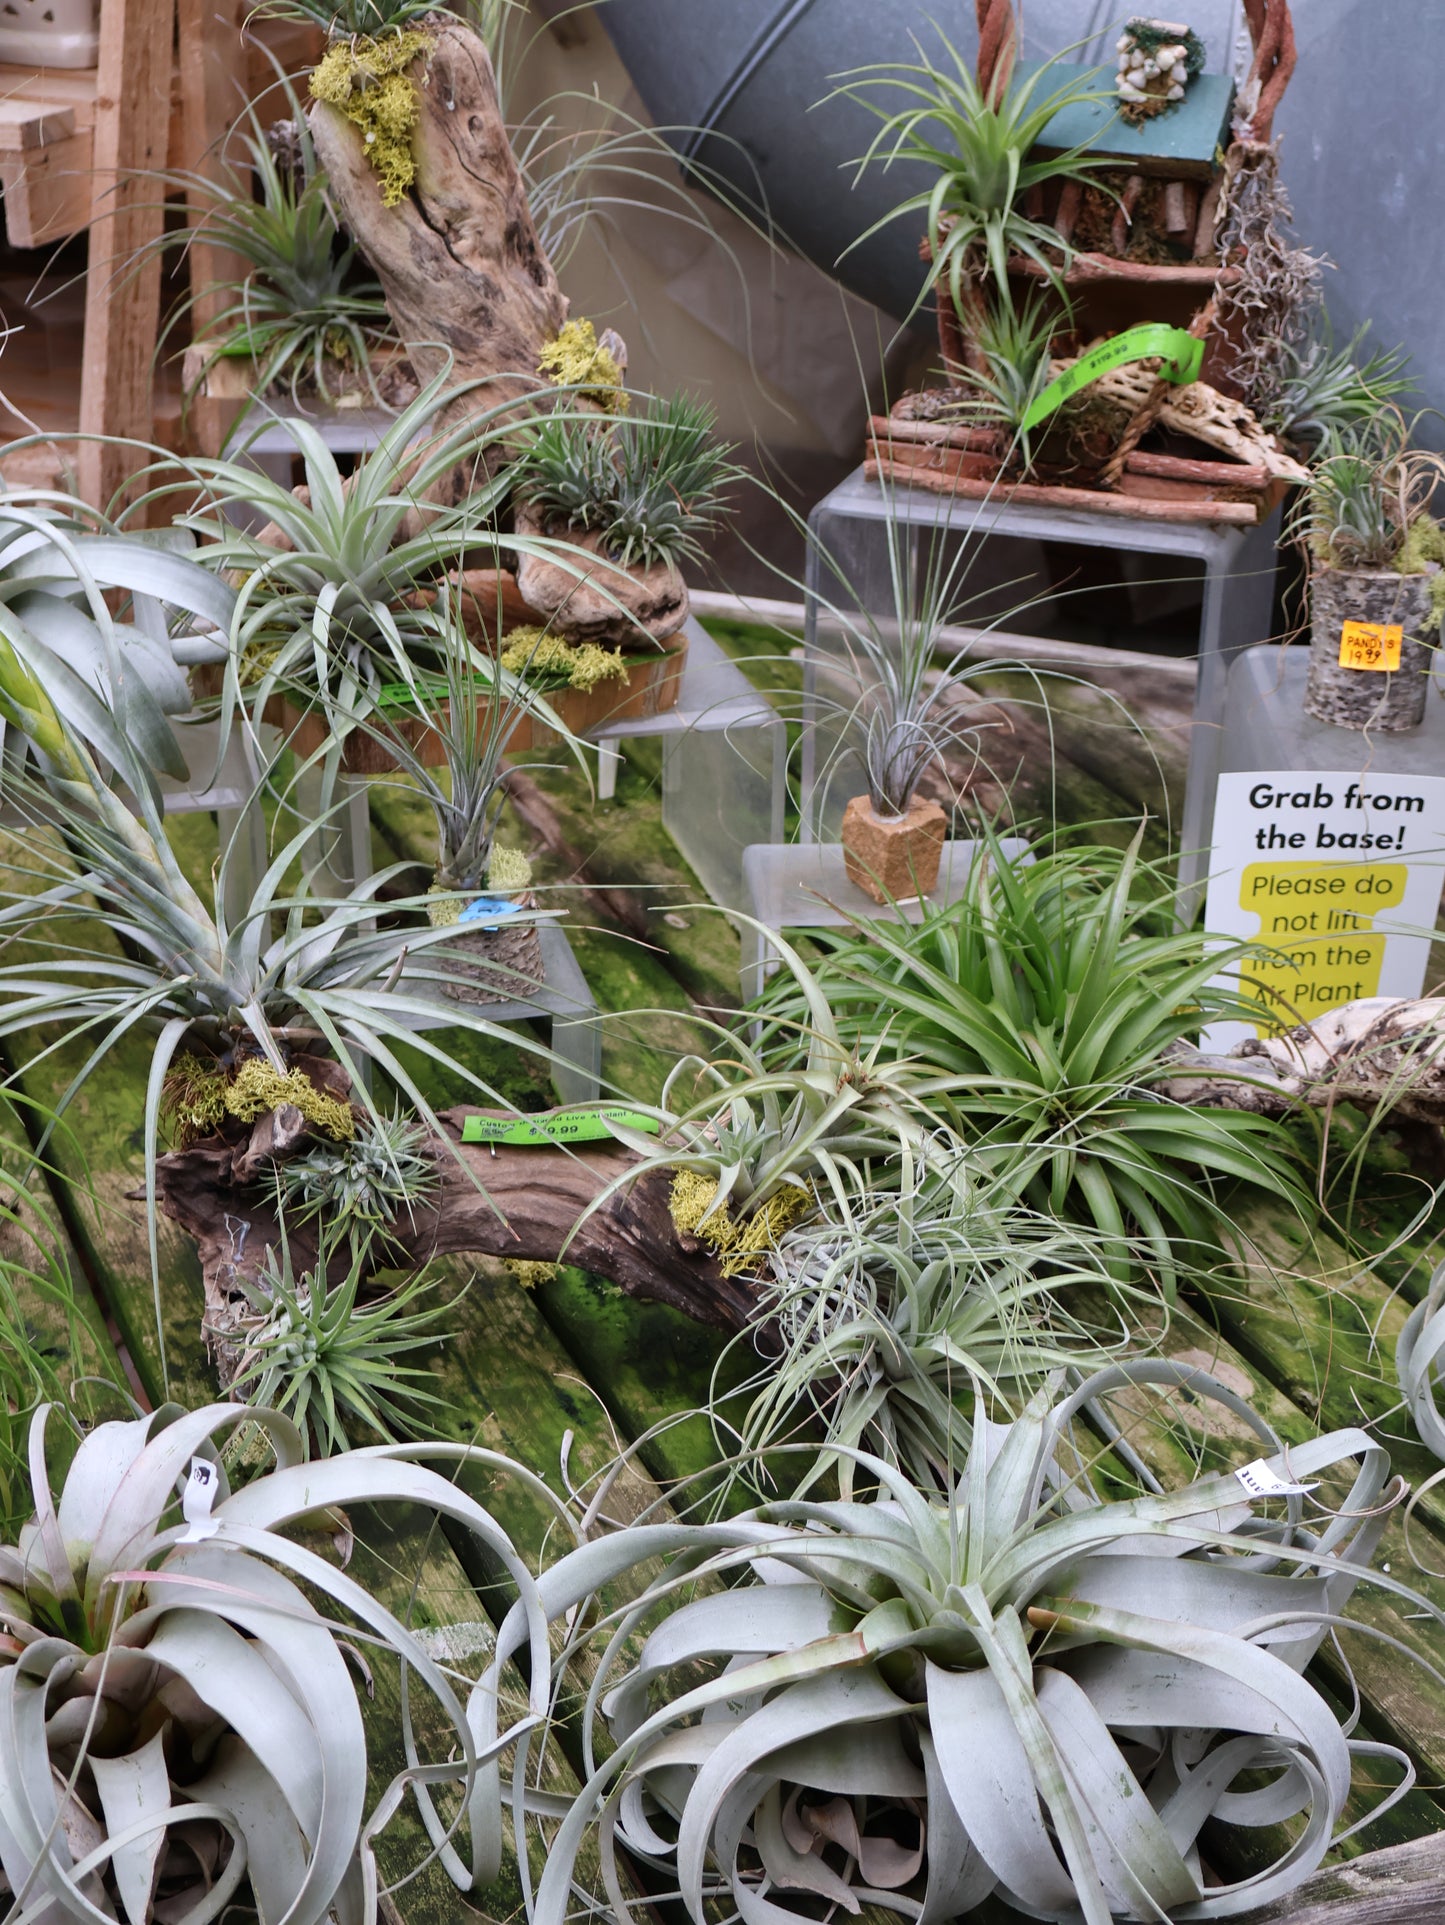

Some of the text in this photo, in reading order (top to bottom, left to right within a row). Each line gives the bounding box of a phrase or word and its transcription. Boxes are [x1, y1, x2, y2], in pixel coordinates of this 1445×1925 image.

[1249, 783, 1425, 813] Grab from
[1255, 823, 1406, 850] the base!
[1252, 874, 1393, 897] Please do
[1272, 908, 1360, 933] not lift
[1326, 945, 1372, 966] the
[1294, 981, 1364, 1004] Plant
[528, 1125, 578, 1136] $9.99
